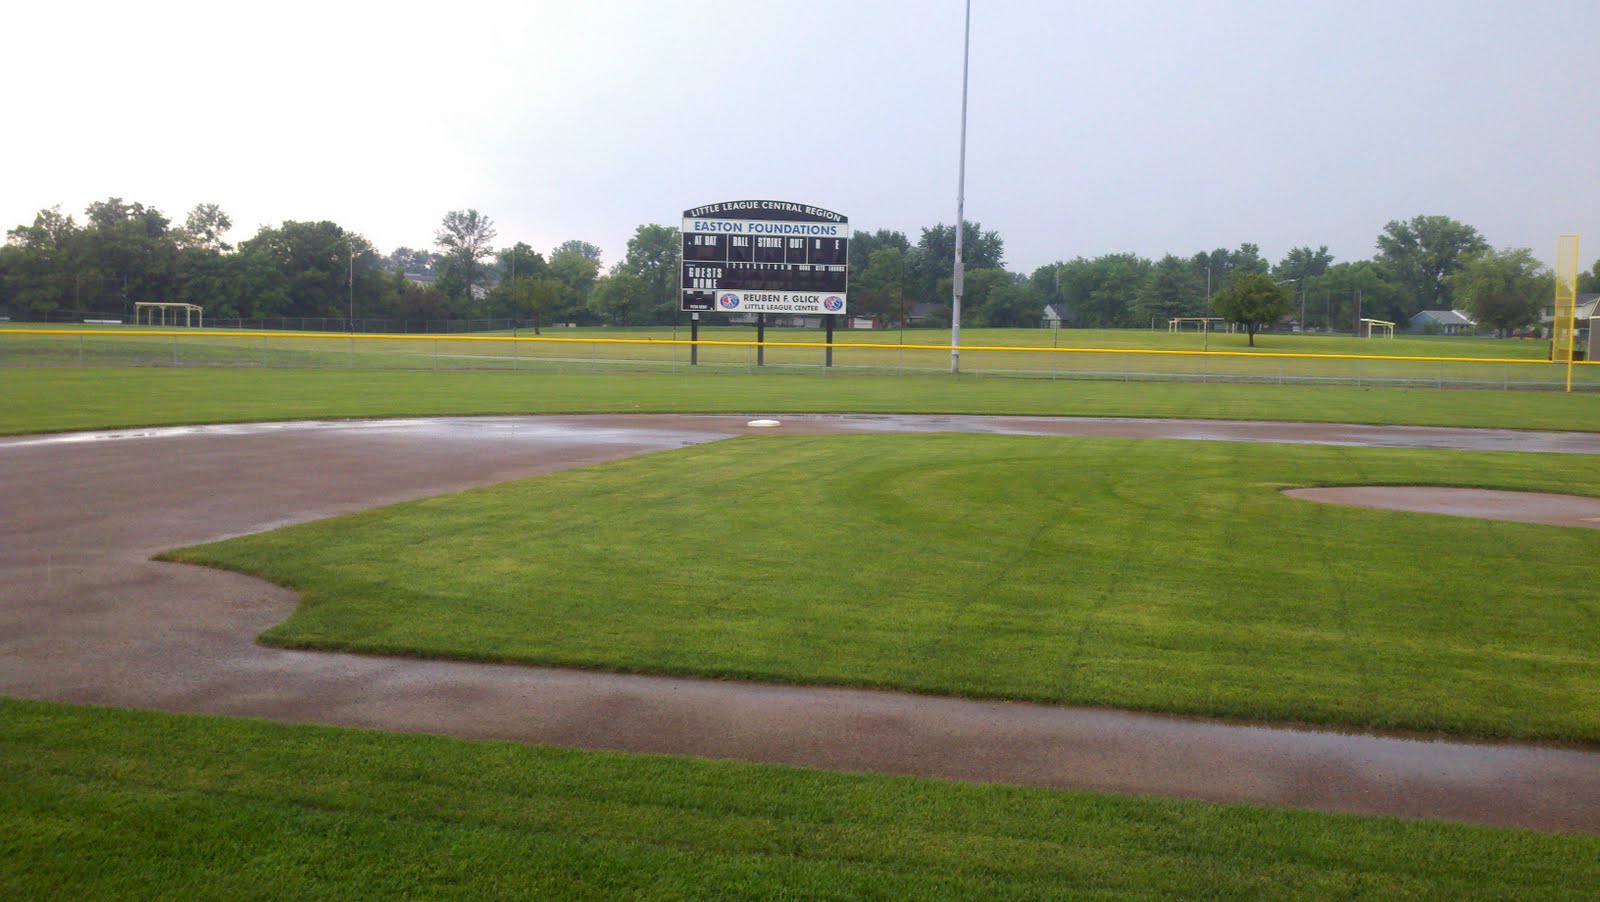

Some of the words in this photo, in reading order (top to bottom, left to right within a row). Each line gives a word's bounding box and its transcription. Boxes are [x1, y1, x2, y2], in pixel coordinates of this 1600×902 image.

[691, 205, 720, 217] LITTLE
[722, 202, 758, 210] LEAGUE
[762, 202, 802, 212] CENTRAL
[805, 206, 841, 222] REGION
[694, 222, 742, 232] EASTON
[748, 224, 837, 236] FOUNDATIONS
[694, 236, 702, 246] AT
[732, 236, 748, 246] BALL
[758, 238, 782, 248] STRIKE
[790, 238, 803, 248] OUT
[688, 268, 722, 278] GUESTS
[693, 278, 717, 288] HOME
[744, 294, 780, 302] REUBEN
